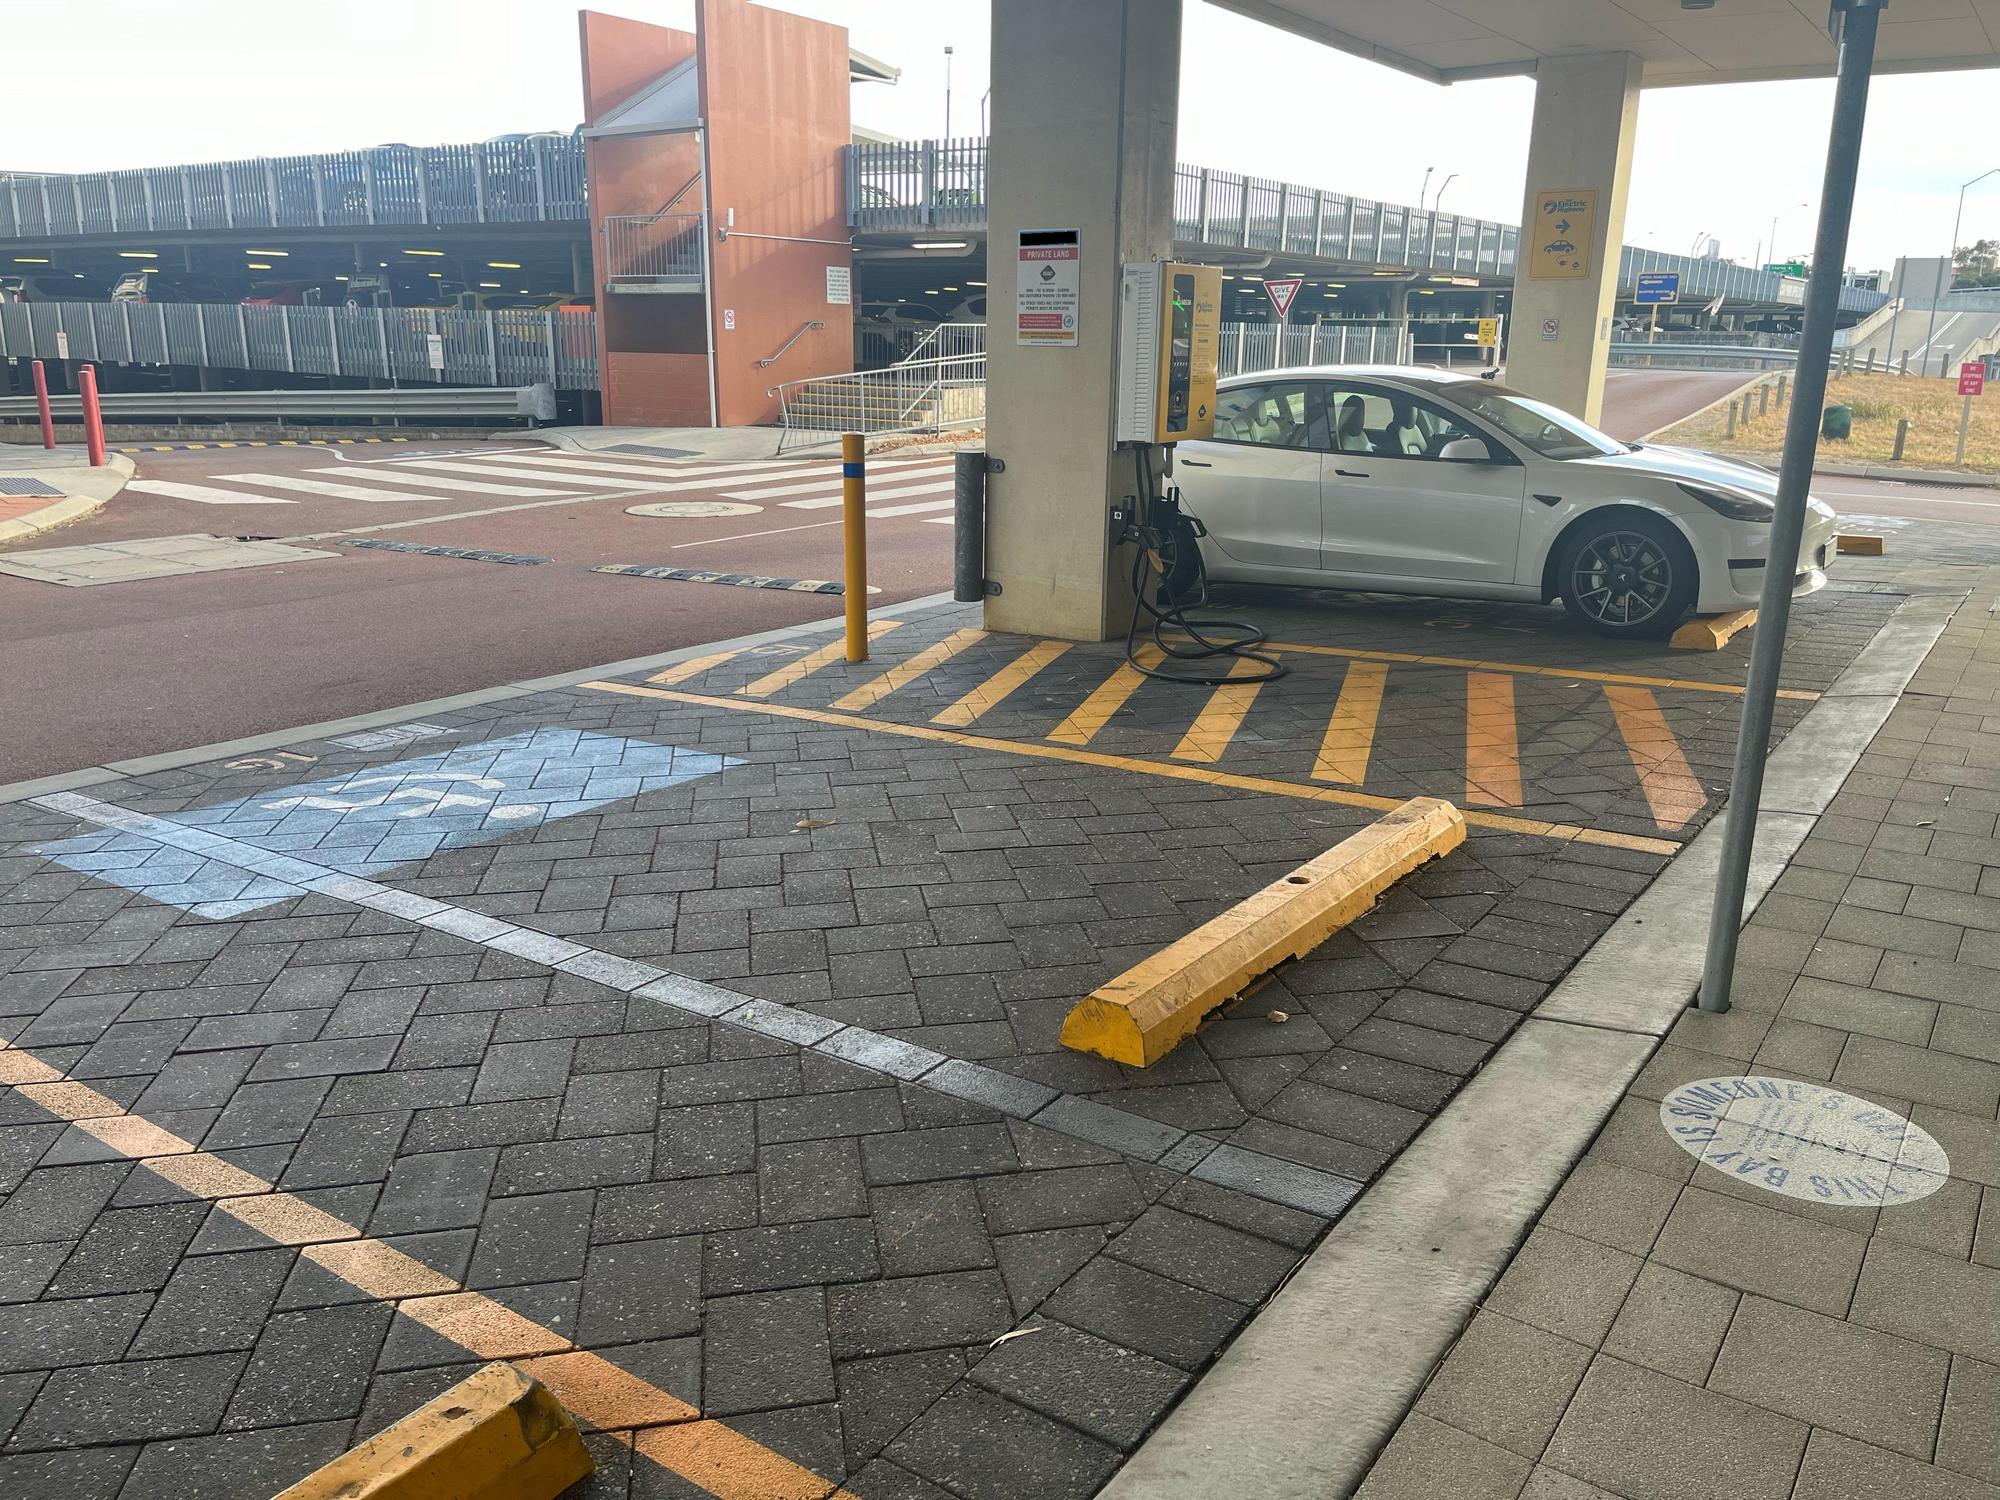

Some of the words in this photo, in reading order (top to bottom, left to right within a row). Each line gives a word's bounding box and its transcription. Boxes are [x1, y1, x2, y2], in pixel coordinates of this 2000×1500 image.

[1557, 206, 1586, 214] Highway
[1027, 250, 1052, 258] PRIVATE
[1053, 250, 1070, 258] LAND
[1675, 1126, 1722, 1143] IS
[1707, 1151, 1790, 1187] BAY
[1808, 1173, 1905, 1200] THIS
